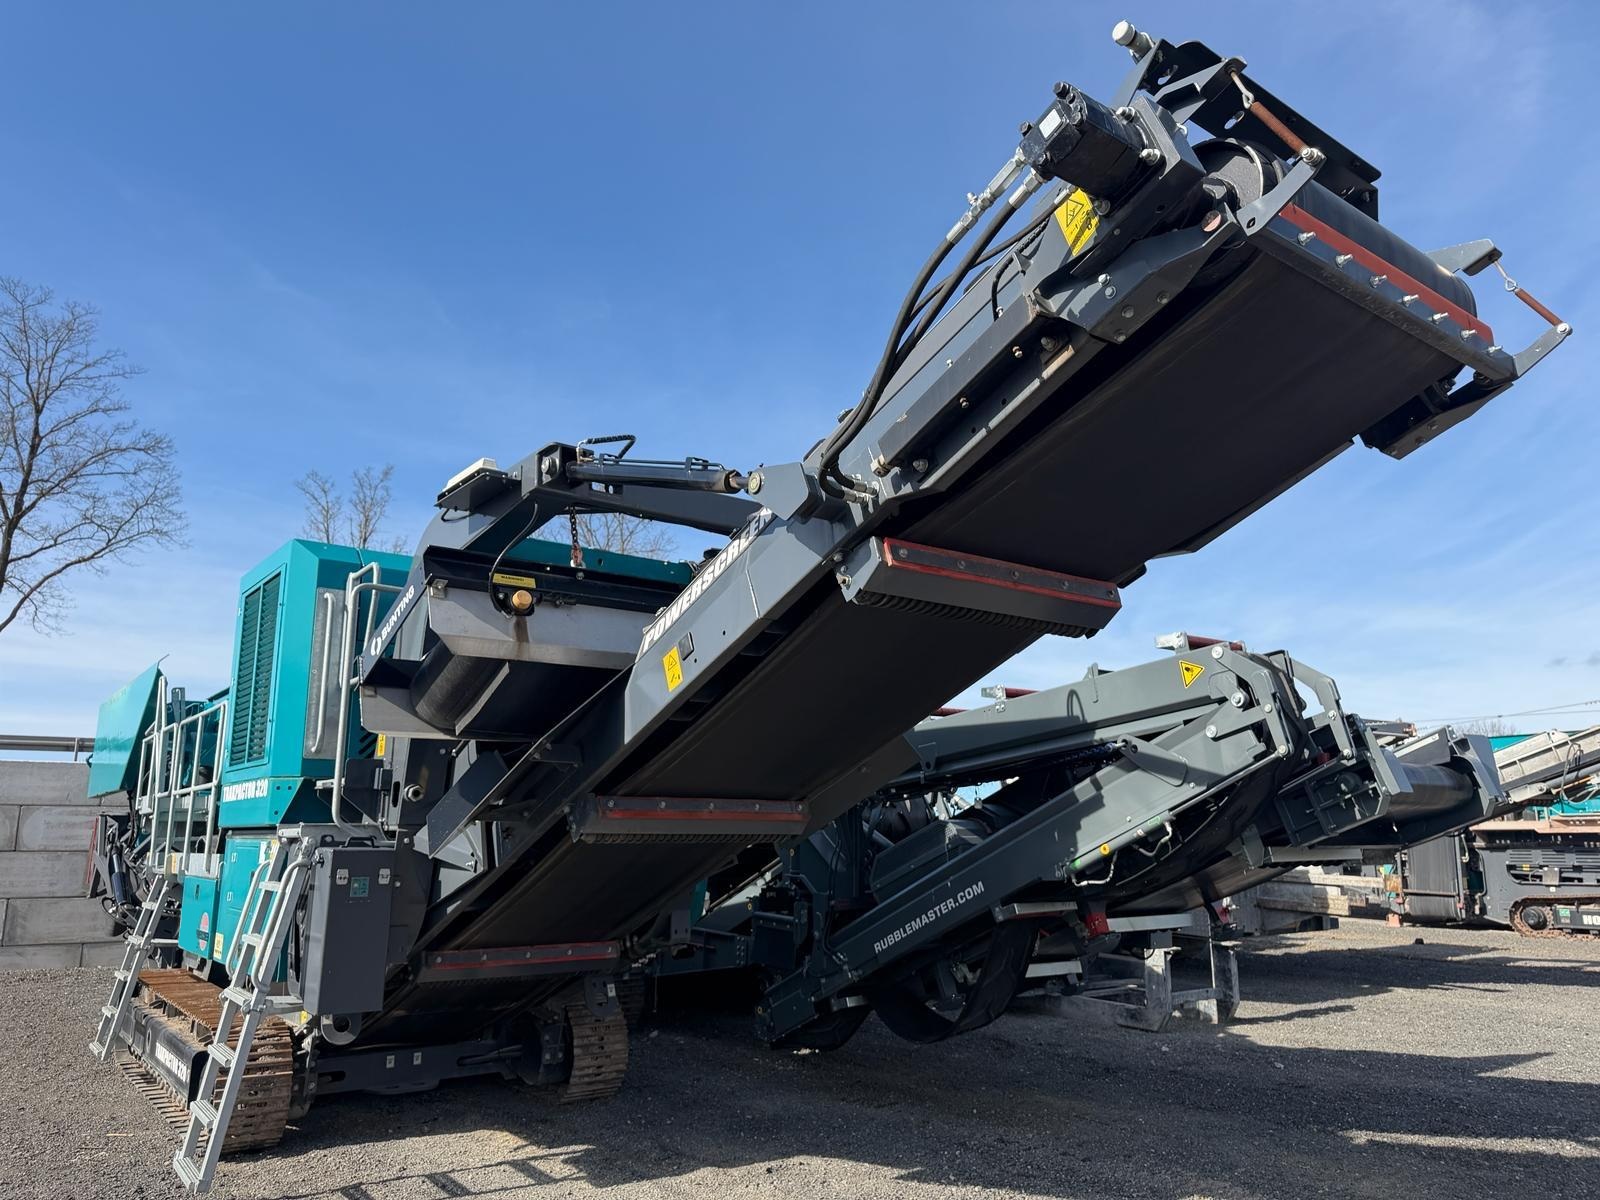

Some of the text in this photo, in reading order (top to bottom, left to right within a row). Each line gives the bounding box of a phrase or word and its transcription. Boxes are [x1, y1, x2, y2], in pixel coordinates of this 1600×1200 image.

[381, 584, 415, 641] BUNTING
[642, 507, 773, 654] POWERSCREEN
[255, 778, 268, 798] 320
[873, 880, 985, 954] RUBBLEMASTER.COM
